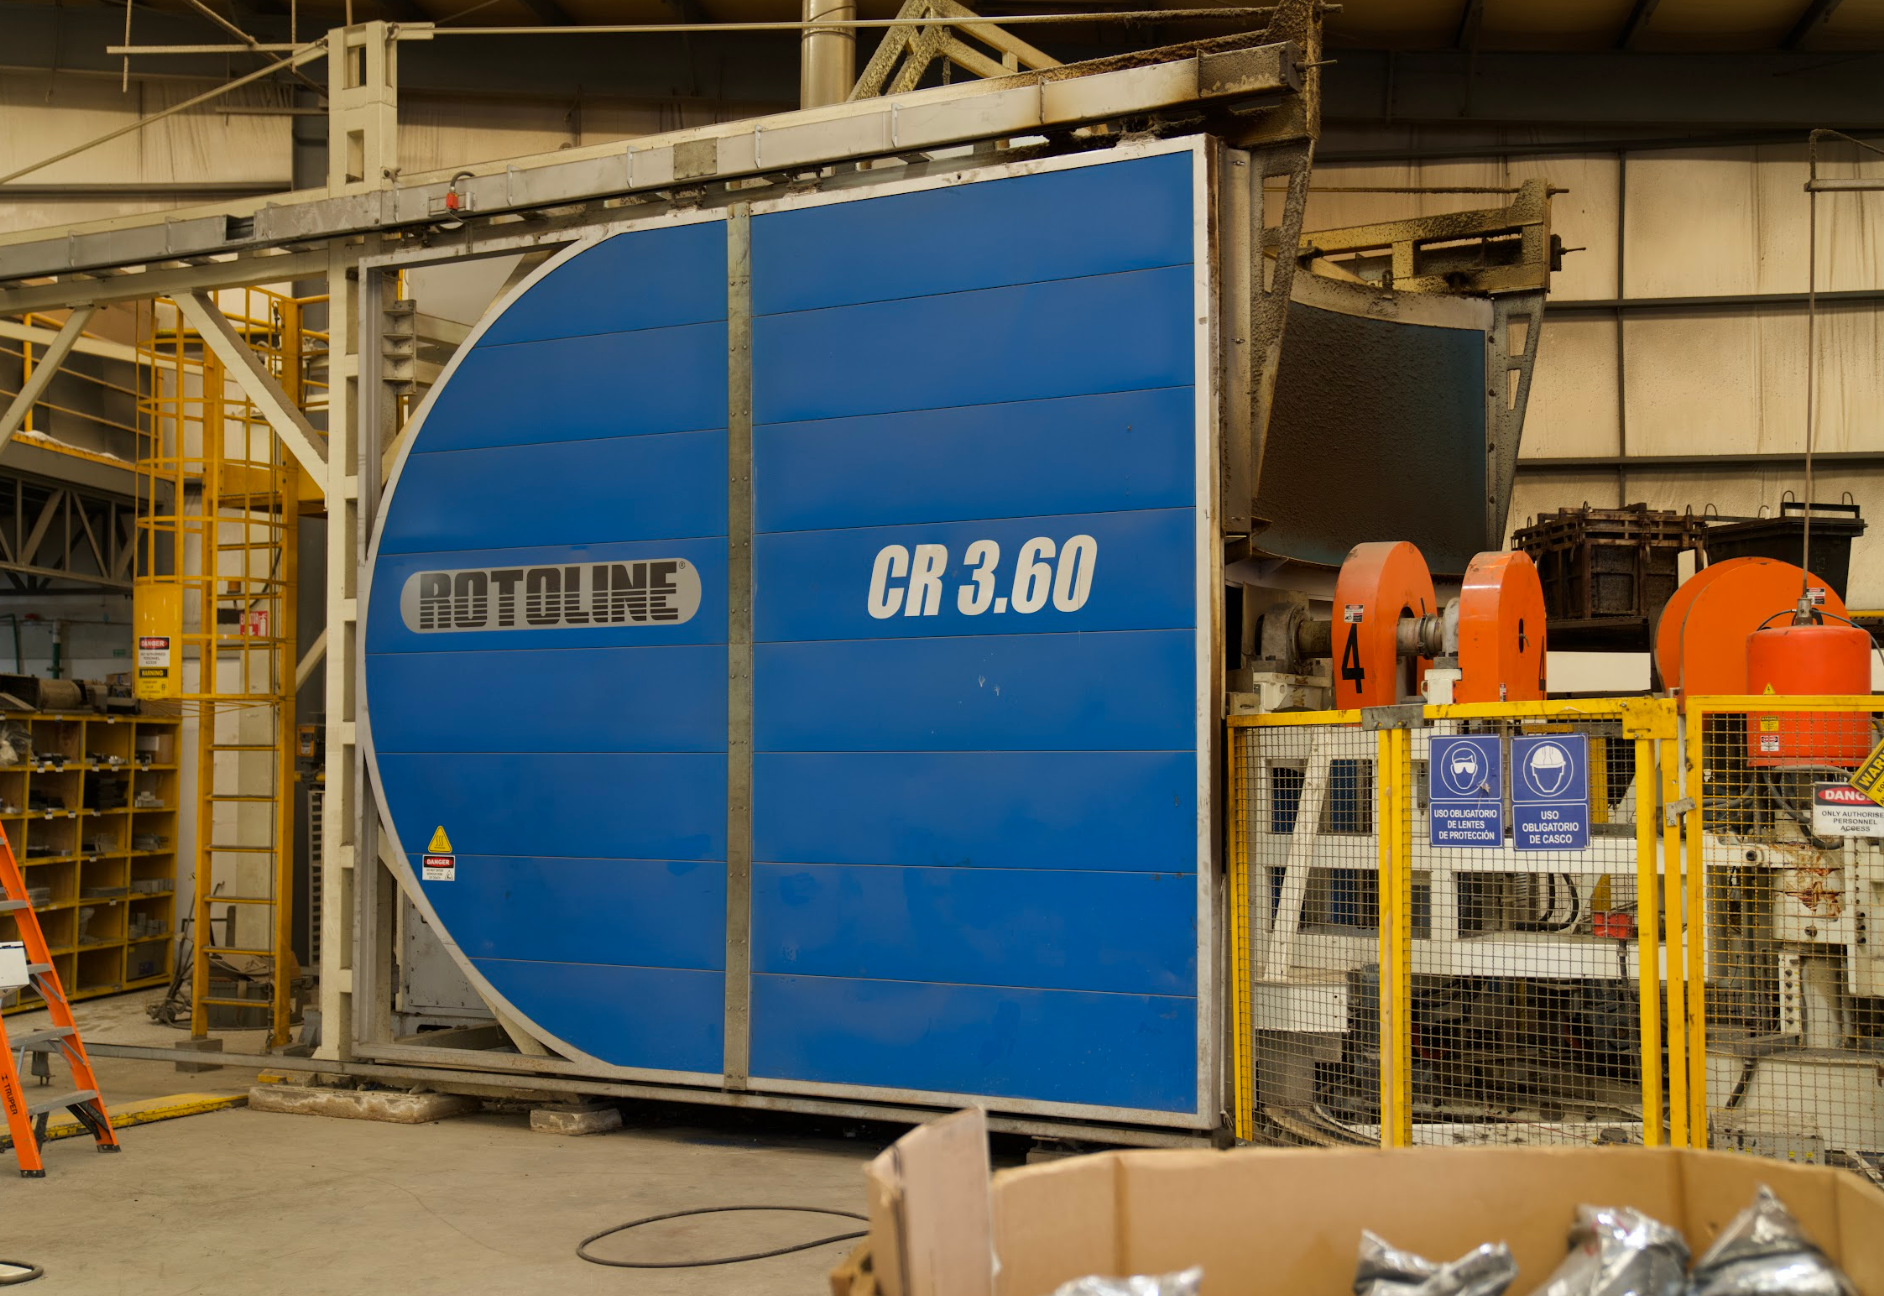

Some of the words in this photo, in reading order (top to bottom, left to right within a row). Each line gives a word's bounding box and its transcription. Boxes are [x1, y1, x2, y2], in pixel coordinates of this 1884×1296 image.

[867, 543, 949, 620] CR
[956, 534, 1098, 616] 3.60
[419, 561, 679, 629] ROTOLINE
[1341, 623, 1365, 694] 4
[1825, 790, 1871, 801] DANG
[1434, 809, 1449, 818] USO
[1450, 809, 1498, 818] OBLIGATORIO
[1541, 810, 1560, 820] USO
[1447, 820, 1458, 829] DE
[1458, 820, 1485, 829] LENTES
[1522, 822, 1580, 832] OBLIGATORIO
[1438, 831, 1449, 840] DE
[1450, 829, 1495, 840] PROTECCIÓN
[1529, 835, 1541, 844] DE
[1543, 834, 1573, 844] CASCO
[4, 1083, 18, 1115] TRUPER
